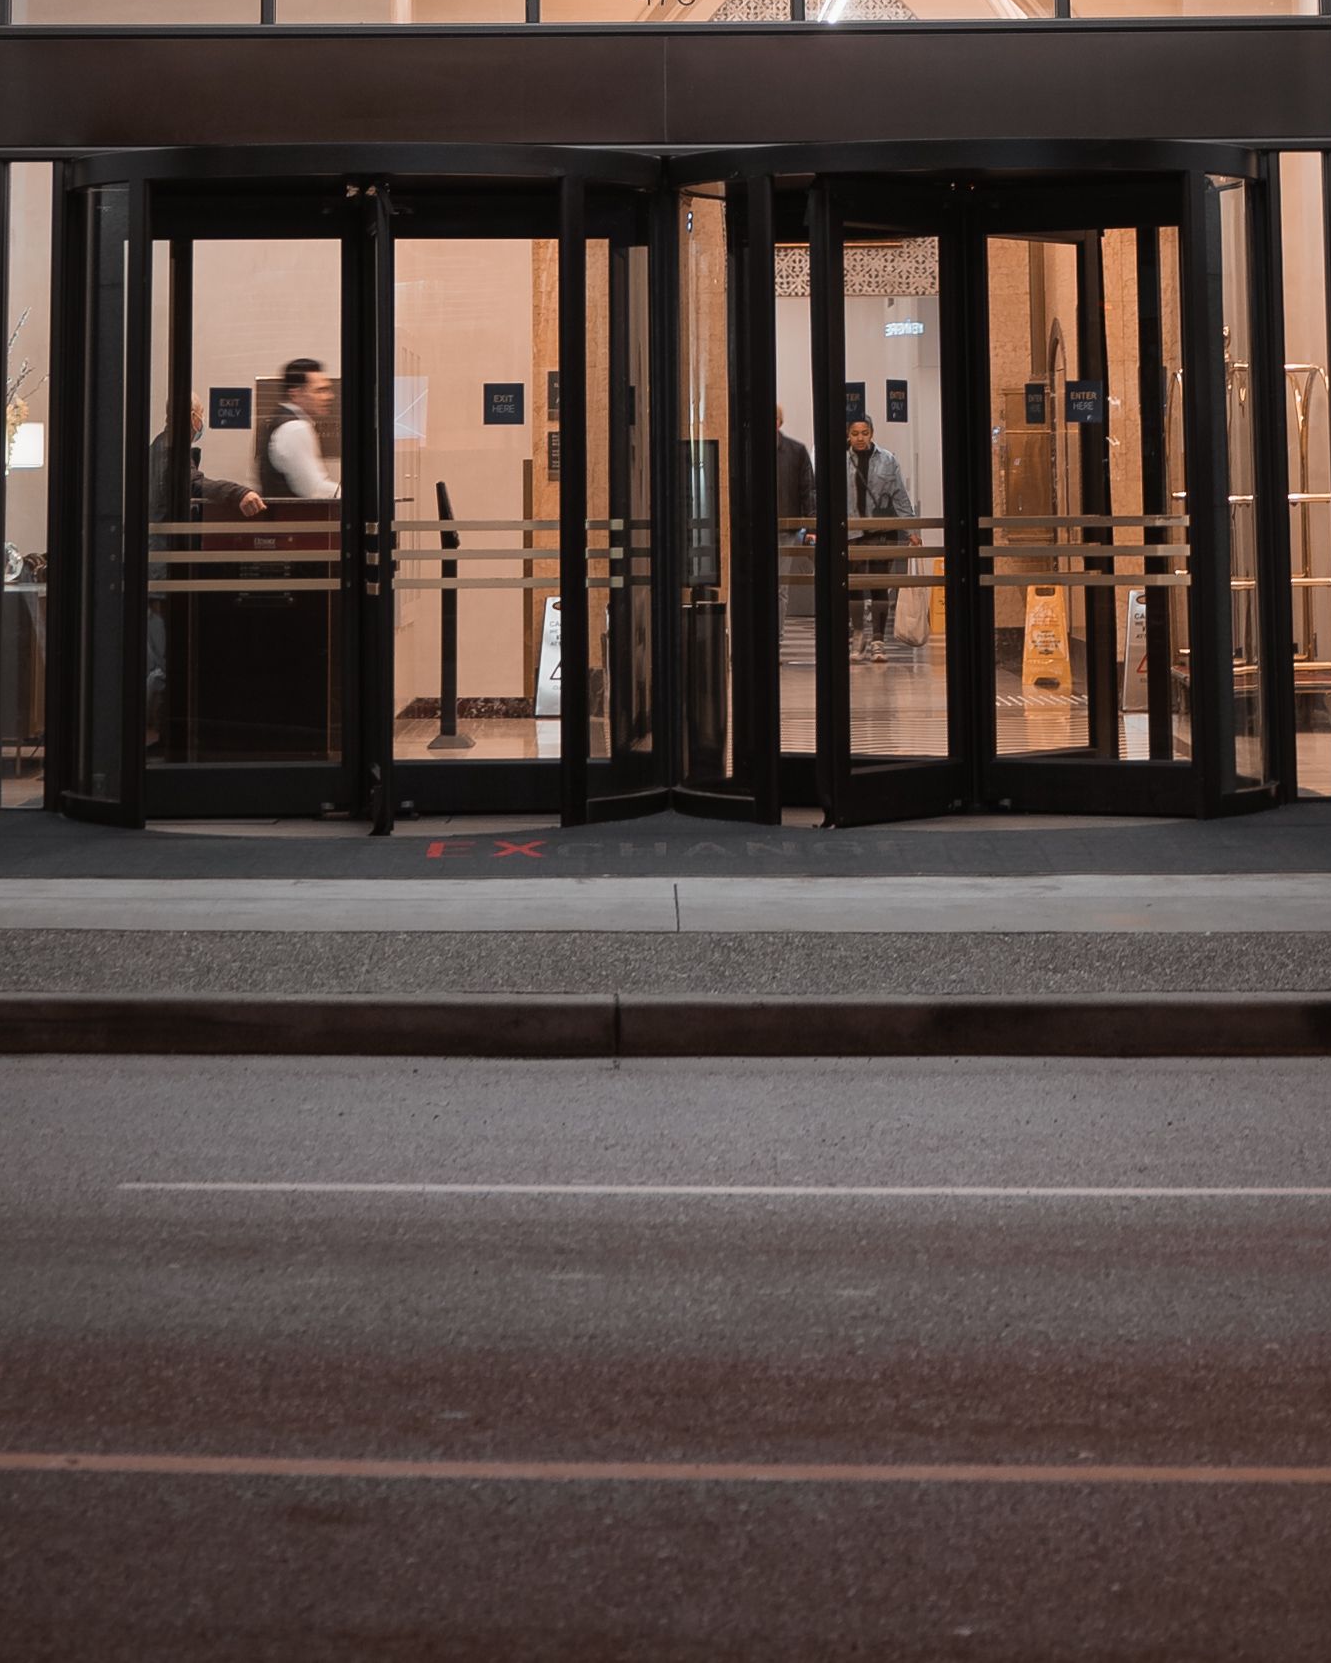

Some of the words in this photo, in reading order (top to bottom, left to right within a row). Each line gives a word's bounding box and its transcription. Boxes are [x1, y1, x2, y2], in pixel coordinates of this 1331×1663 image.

[493, 394, 514, 403] EXIT
[1070, 391, 1097, 400] ENTER
[492, 404, 515, 413] HERE
[1073, 401, 1094, 411] HERE
